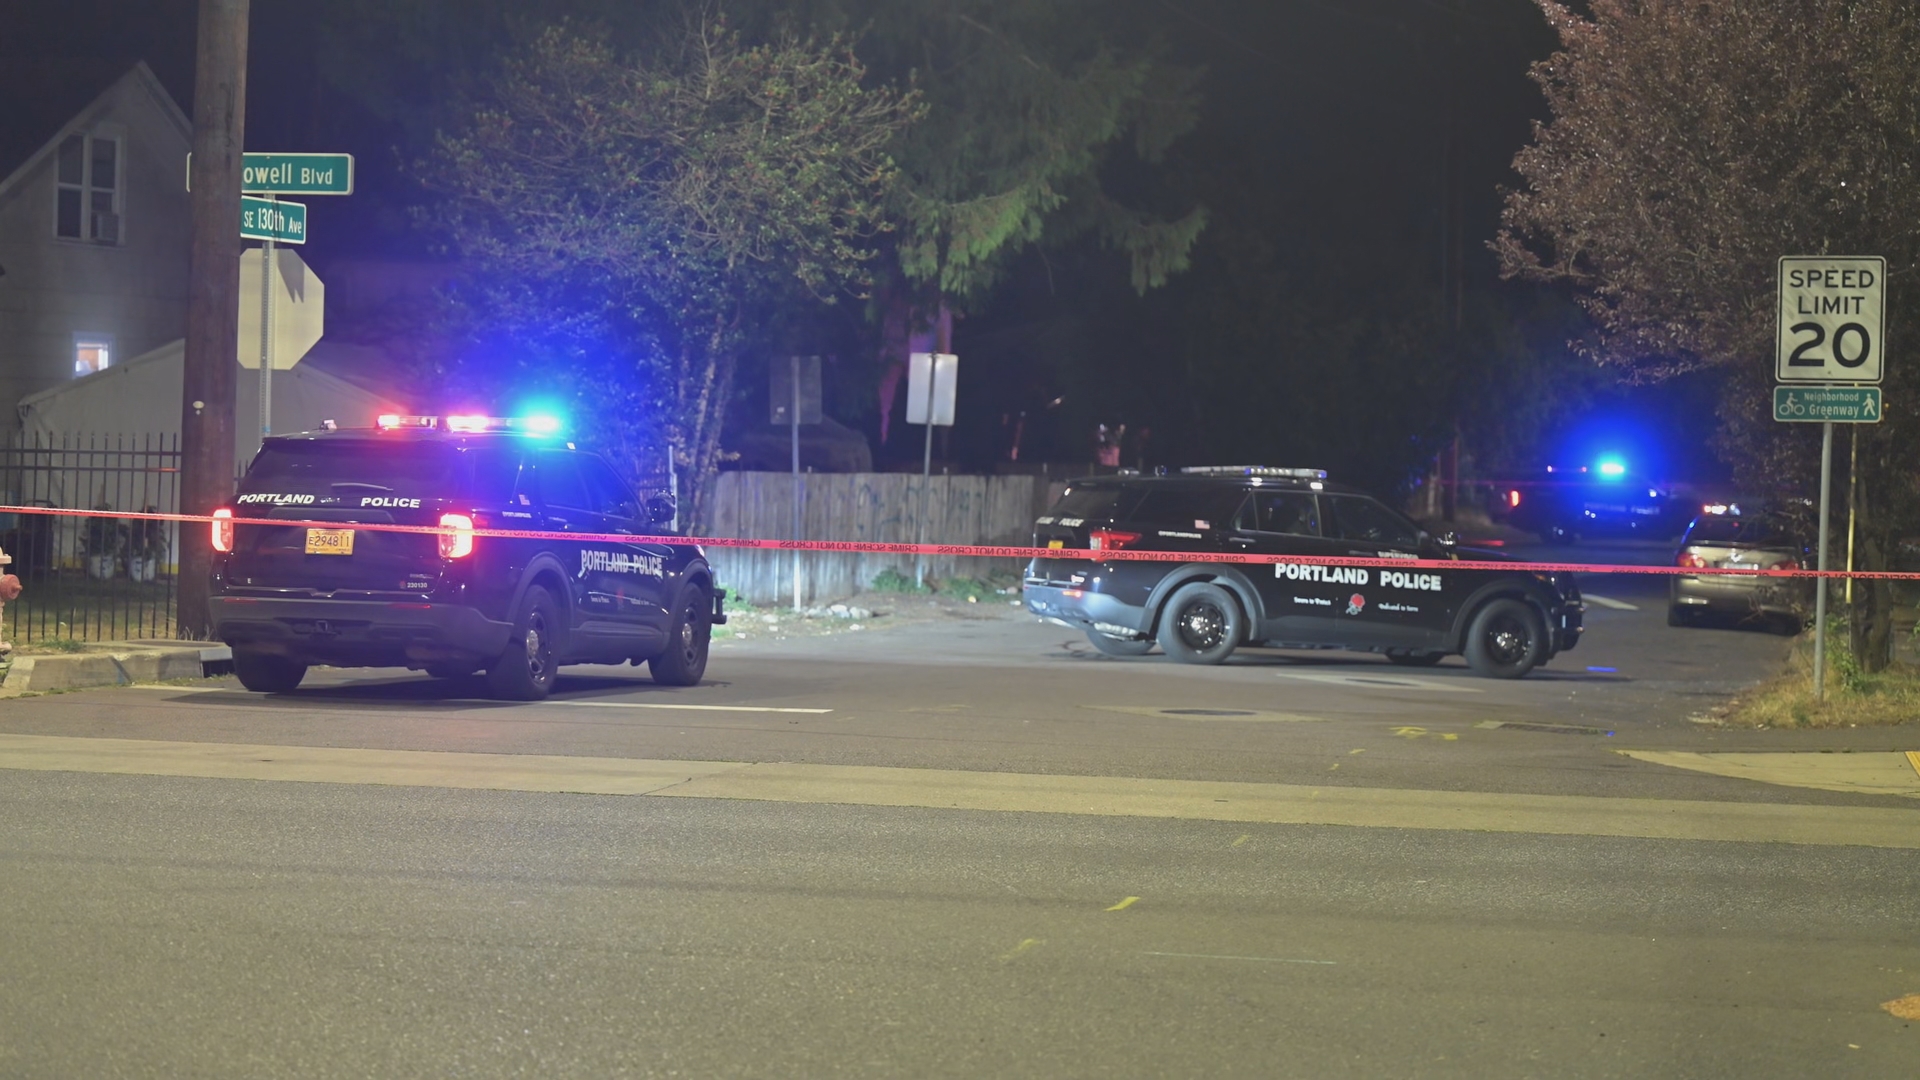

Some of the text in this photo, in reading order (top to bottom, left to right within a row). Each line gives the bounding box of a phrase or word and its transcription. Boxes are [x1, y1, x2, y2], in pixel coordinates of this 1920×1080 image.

[243, 162, 333, 185] owell Blvd
[243, 207, 302, 234] SE 130th Ave
[1789, 269, 1875, 288] SPEED
[1797, 296, 1865, 315] LIMIT
[1788, 321, 1871, 368] 20
[1803, 392, 1859, 403] Neighborhood
[1809, 405, 1859, 418] Greenway
[237, 494, 421, 508] PORTLAND POLICE
[308, 535, 350, 547] E294811
[581, 550, 663, 577] PORTLAND POLICE
[1275, 562, 1442, 591] PORTLAND POLICE
